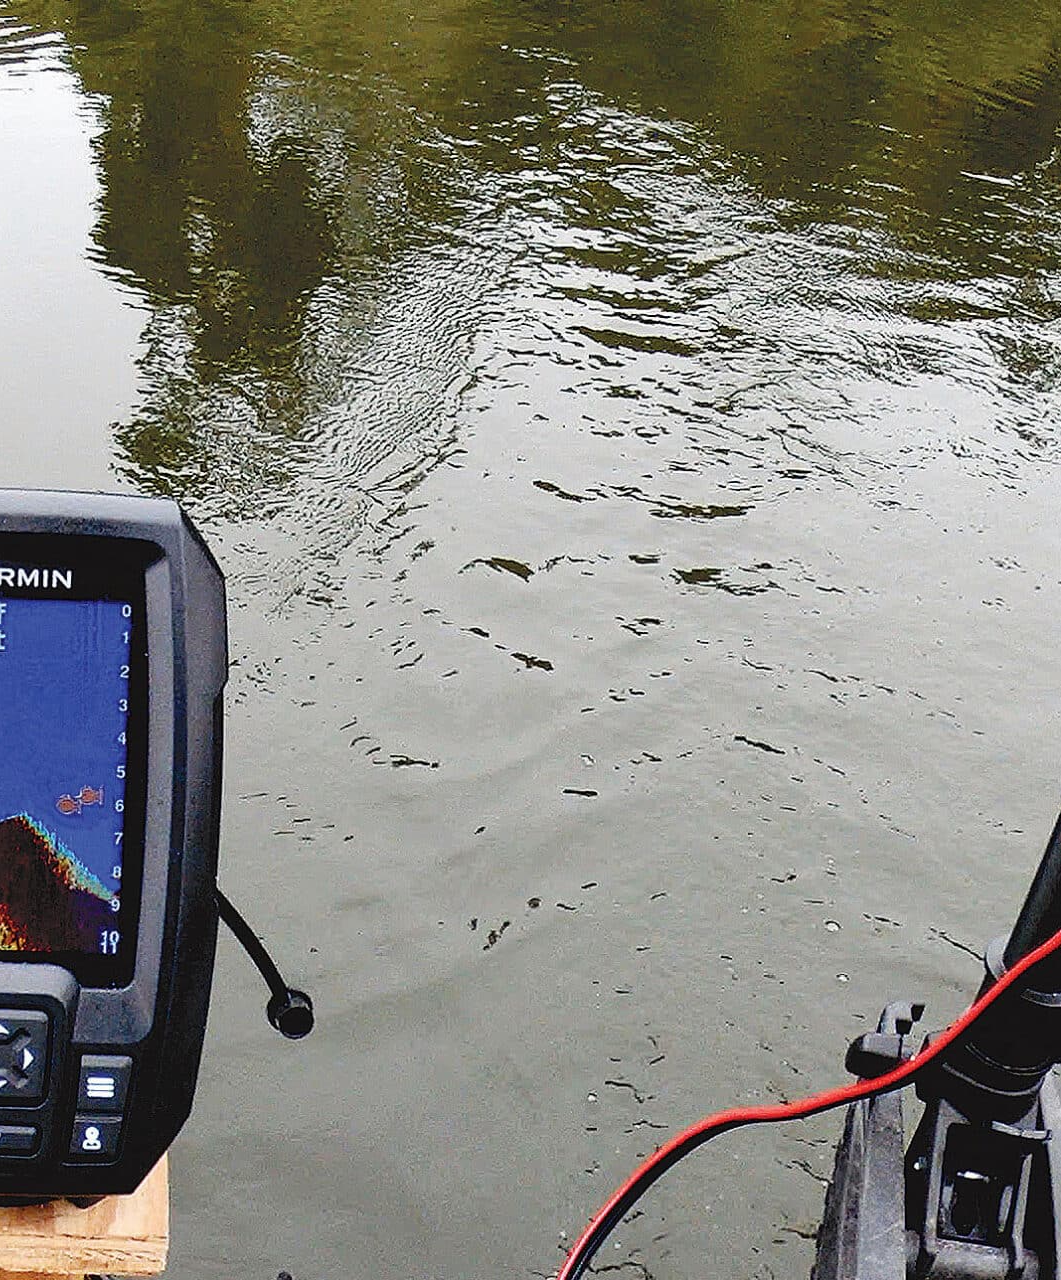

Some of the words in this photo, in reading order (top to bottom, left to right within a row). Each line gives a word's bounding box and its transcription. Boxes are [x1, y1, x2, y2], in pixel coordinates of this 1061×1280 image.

[122, 604, 132, 617] 0
[122, 631, 129, 643] 1
[120, 665, 130, 678] 2
[118, 699, 128, 712] 3
[117, 732, 127, 745] 4
[116, 766, 126, 779] 5
[115, 800, 125, 812] 6
[114, 832, 123, 845] 7
[112, 866, 122, 879] 8
[111, 899, 120, 912] 9
